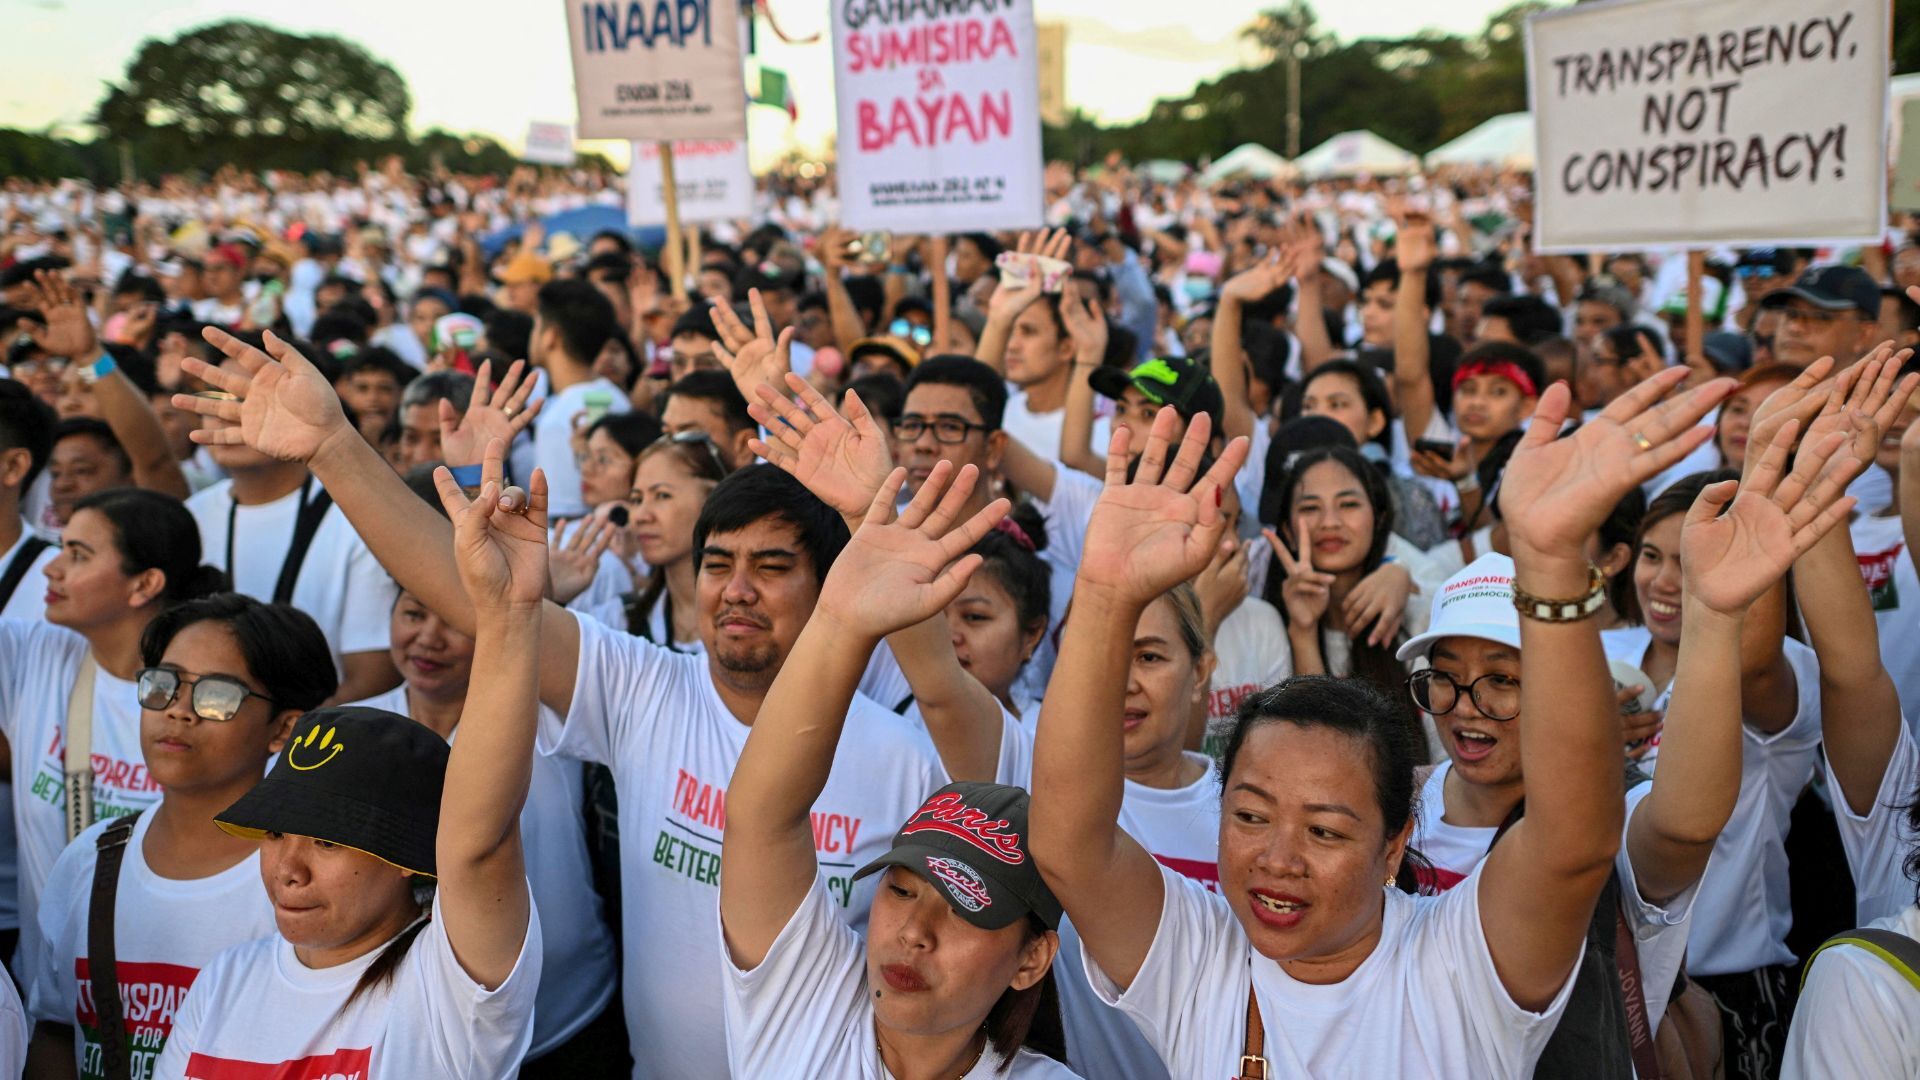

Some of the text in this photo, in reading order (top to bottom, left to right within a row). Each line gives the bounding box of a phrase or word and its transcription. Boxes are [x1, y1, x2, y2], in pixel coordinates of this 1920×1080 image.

[583, 0, 712, 53] INAAPI
[843, 0, 1013, 29] GAHA
[847, 17, 1018, 72] SUMISIRA
[1554, 12, 1857, 96] TRANSPARENCY,
[917, 69, 944, 92] SA
[858, 92, 1013, 153] BAYAN
[1642, 82, 1742, 135] NOT
[1562, 124, 1848, 195] CONSPIRACY!
[902, 791, 1025, 865] Paris
[653, 830, 722, 887] BETTER
[926, 856, 992, 907] Paris
[1620, 969, 1646, 1048] JOVANNI
[132, 1026, 163, 1049] FOR
